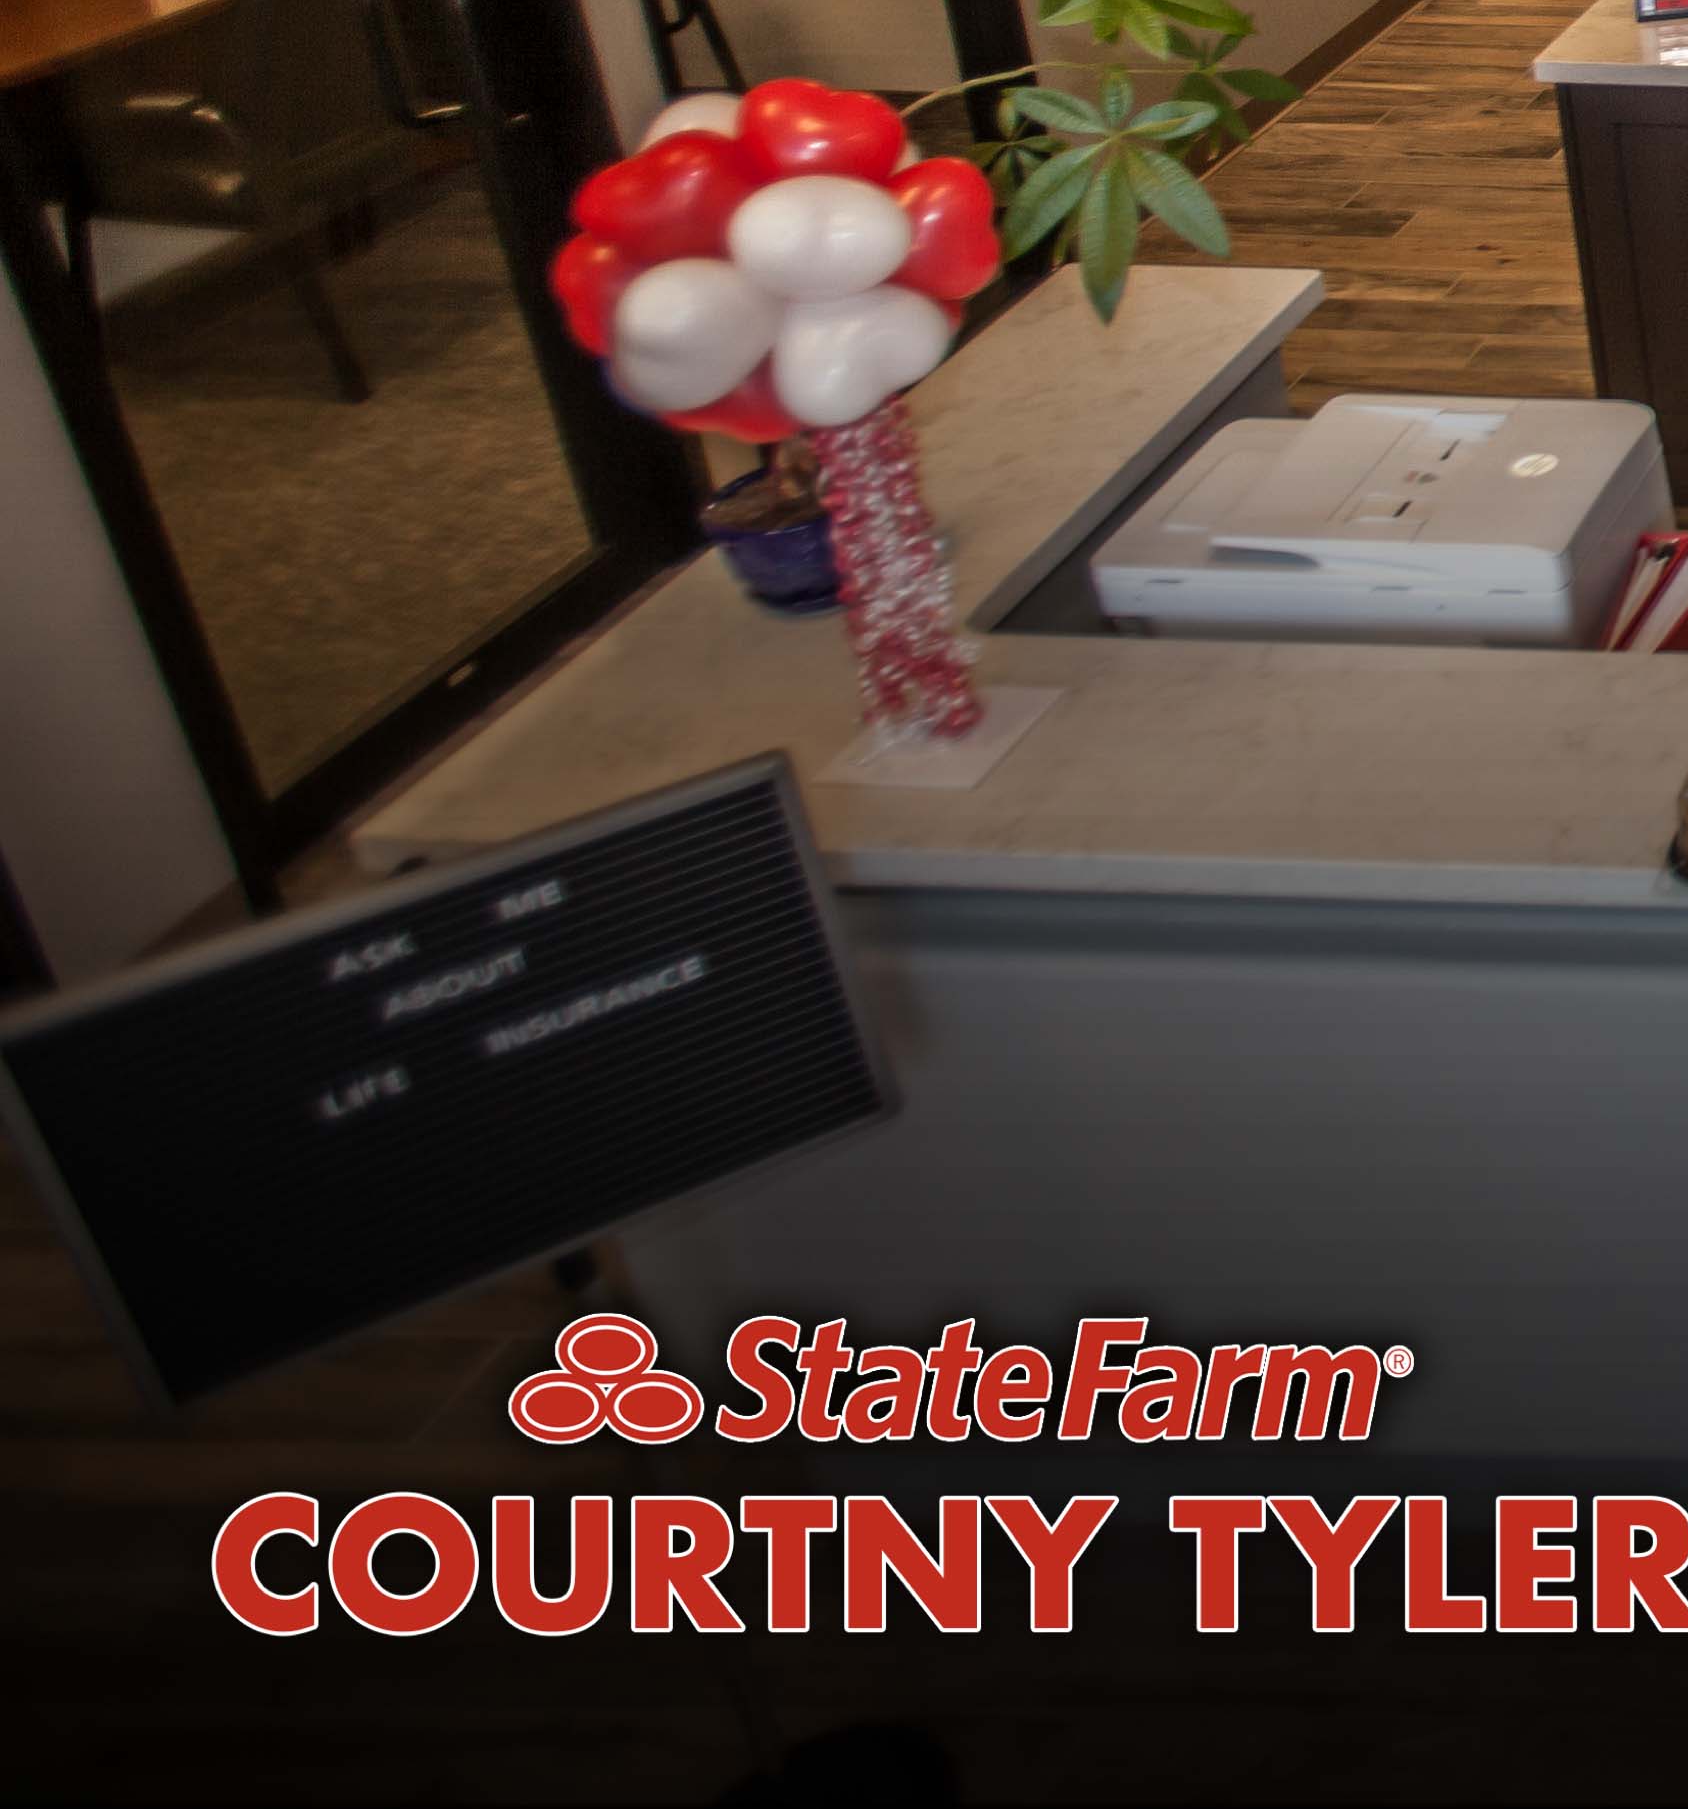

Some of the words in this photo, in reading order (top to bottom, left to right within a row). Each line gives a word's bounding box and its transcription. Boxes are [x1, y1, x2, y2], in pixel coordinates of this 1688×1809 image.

[327, 933, 418, 981] ASK
[497, 881, 565, 920] ME
[383, 947, 528, 1020] ABOUT
[319, 1067, 409, 1119] LIFE
[484, 953, 708, 1056] INSURANCE
